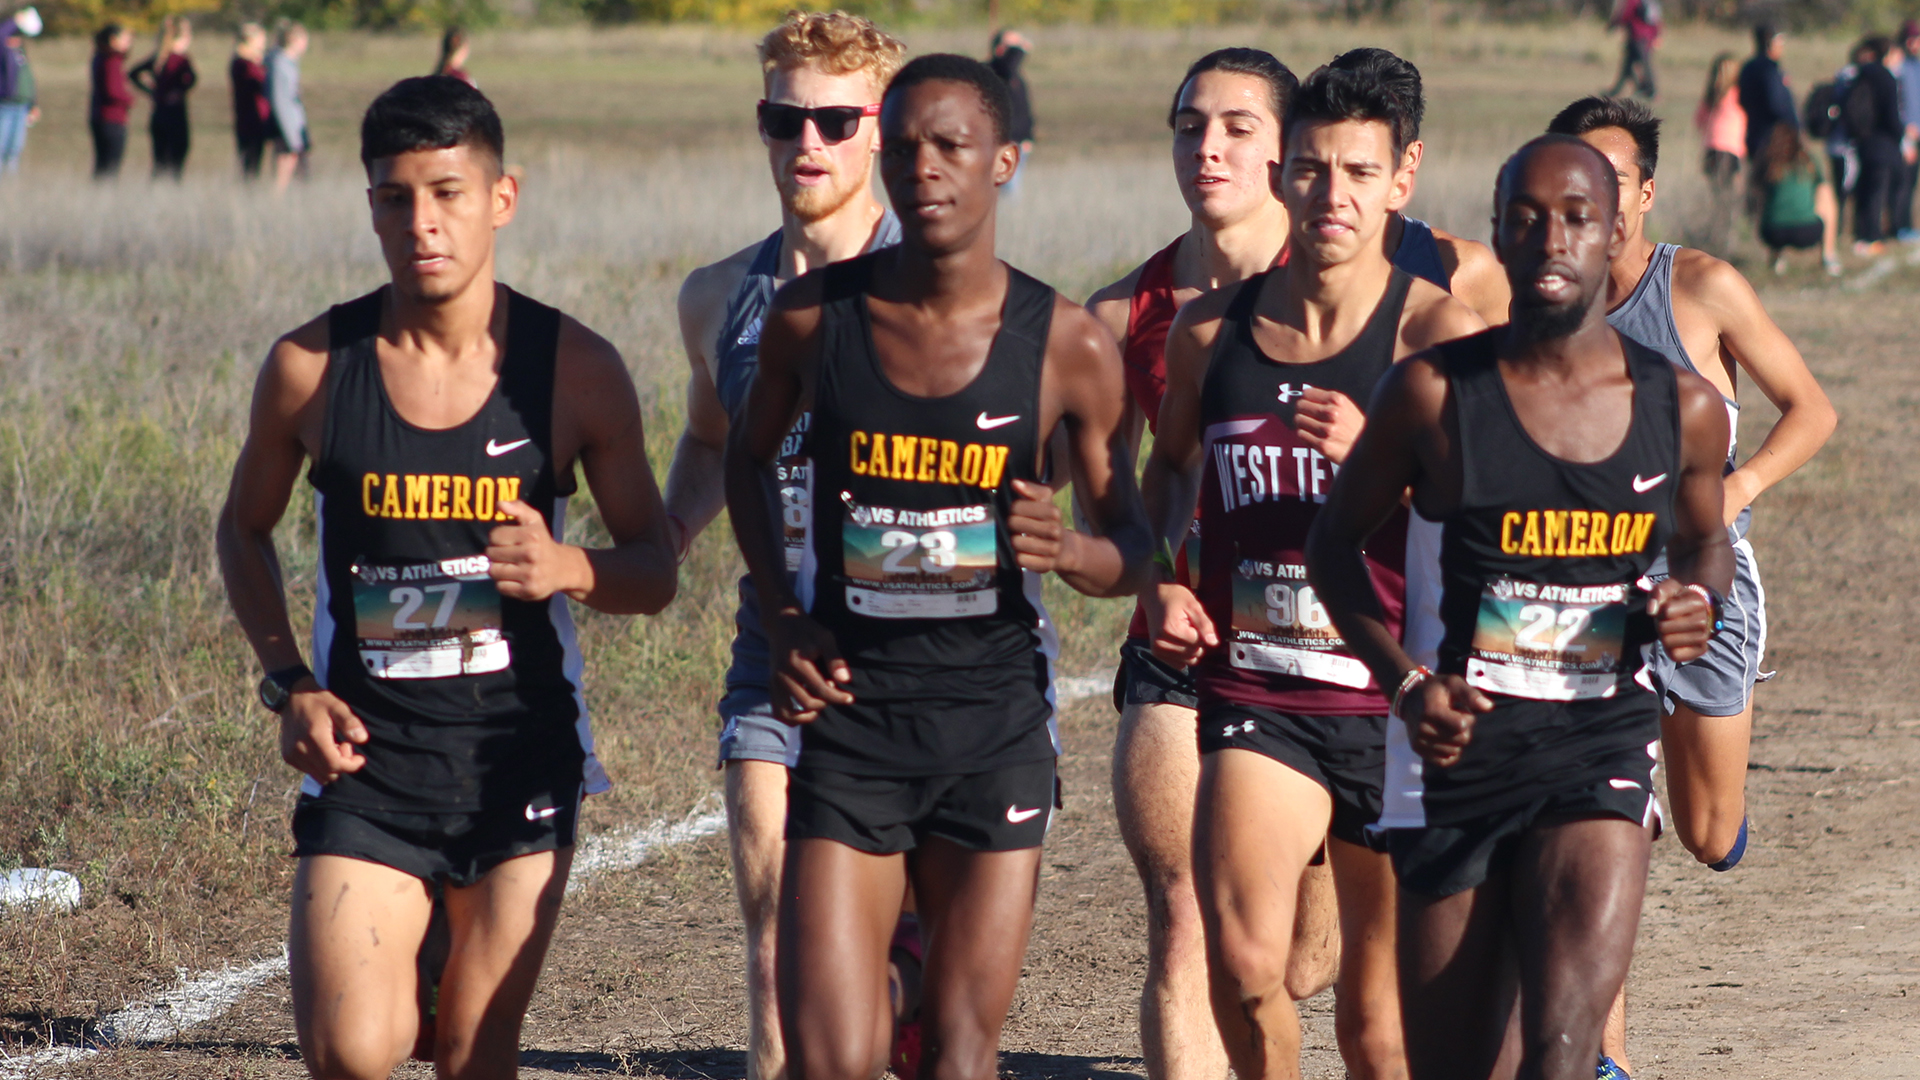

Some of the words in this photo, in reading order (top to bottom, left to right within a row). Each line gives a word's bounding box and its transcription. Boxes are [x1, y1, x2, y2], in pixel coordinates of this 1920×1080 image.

[851, 430, 1009, 489] CAMERON
[1213, 443, 1282, 513] WEST
[1292, 447, 1339, 505] TE
[362, 472, 521, 521] CAMERON
[871, 506, 895, 524] VS
[896, 505, 987, 527] ATHLETICS
[881, 530, 957, 574] 23
[1501, 510, 1656, 557] CAMERON
[375, 566, 399, 581] VS
[401, 555, 490, 581] ATHLETICS
[1254, 561, 1274, 577] VS
[389, 581, 462, 630] 27
[1264, 583, 1331, 629] 96
[1513, 581, 1538, 599] VS
[1538, 583, 1624, 604] ATHLETICS
[1514, 604, 1591, 651] 22
